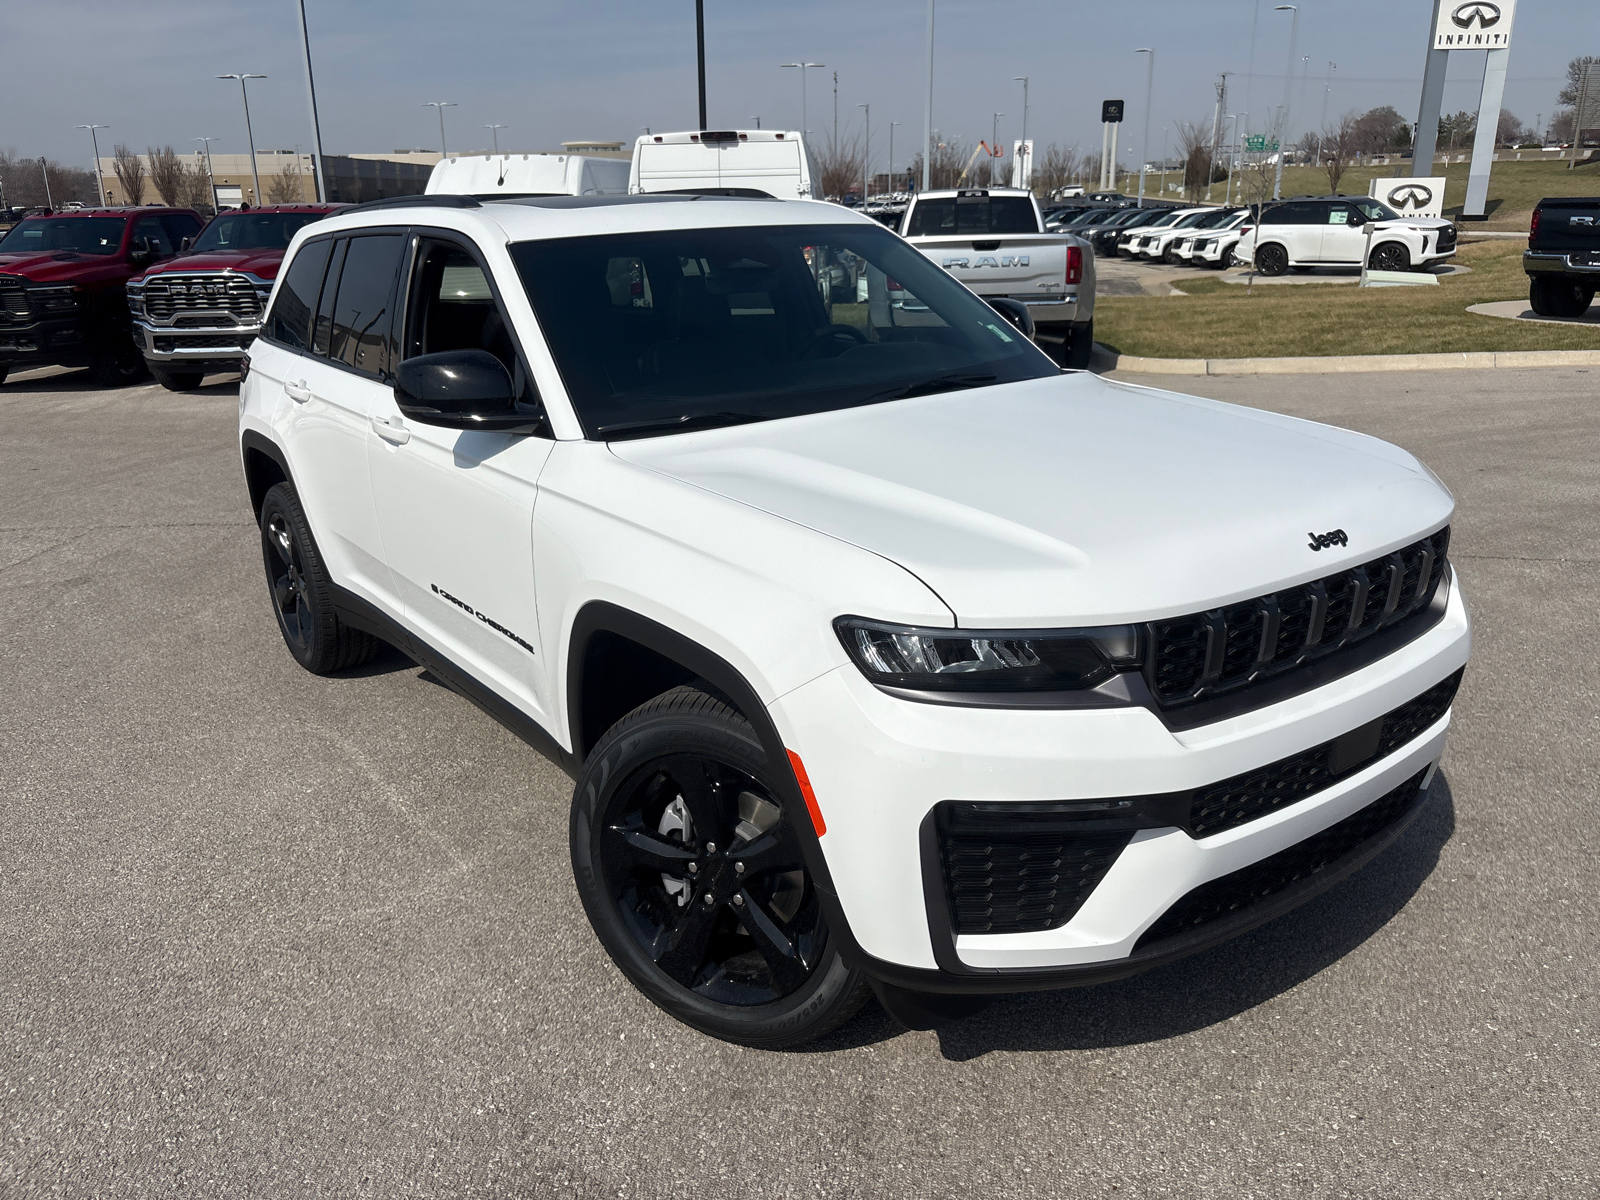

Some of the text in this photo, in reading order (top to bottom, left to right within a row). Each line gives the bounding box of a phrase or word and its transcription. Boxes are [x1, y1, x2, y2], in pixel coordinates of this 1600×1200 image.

[1438, 34, 1507, 45] INFINITI
[942, 256, 1030, 269] RAM
[170, 284, 225, 294] RAM
[1307, 528, 1349, 552] Jeep
